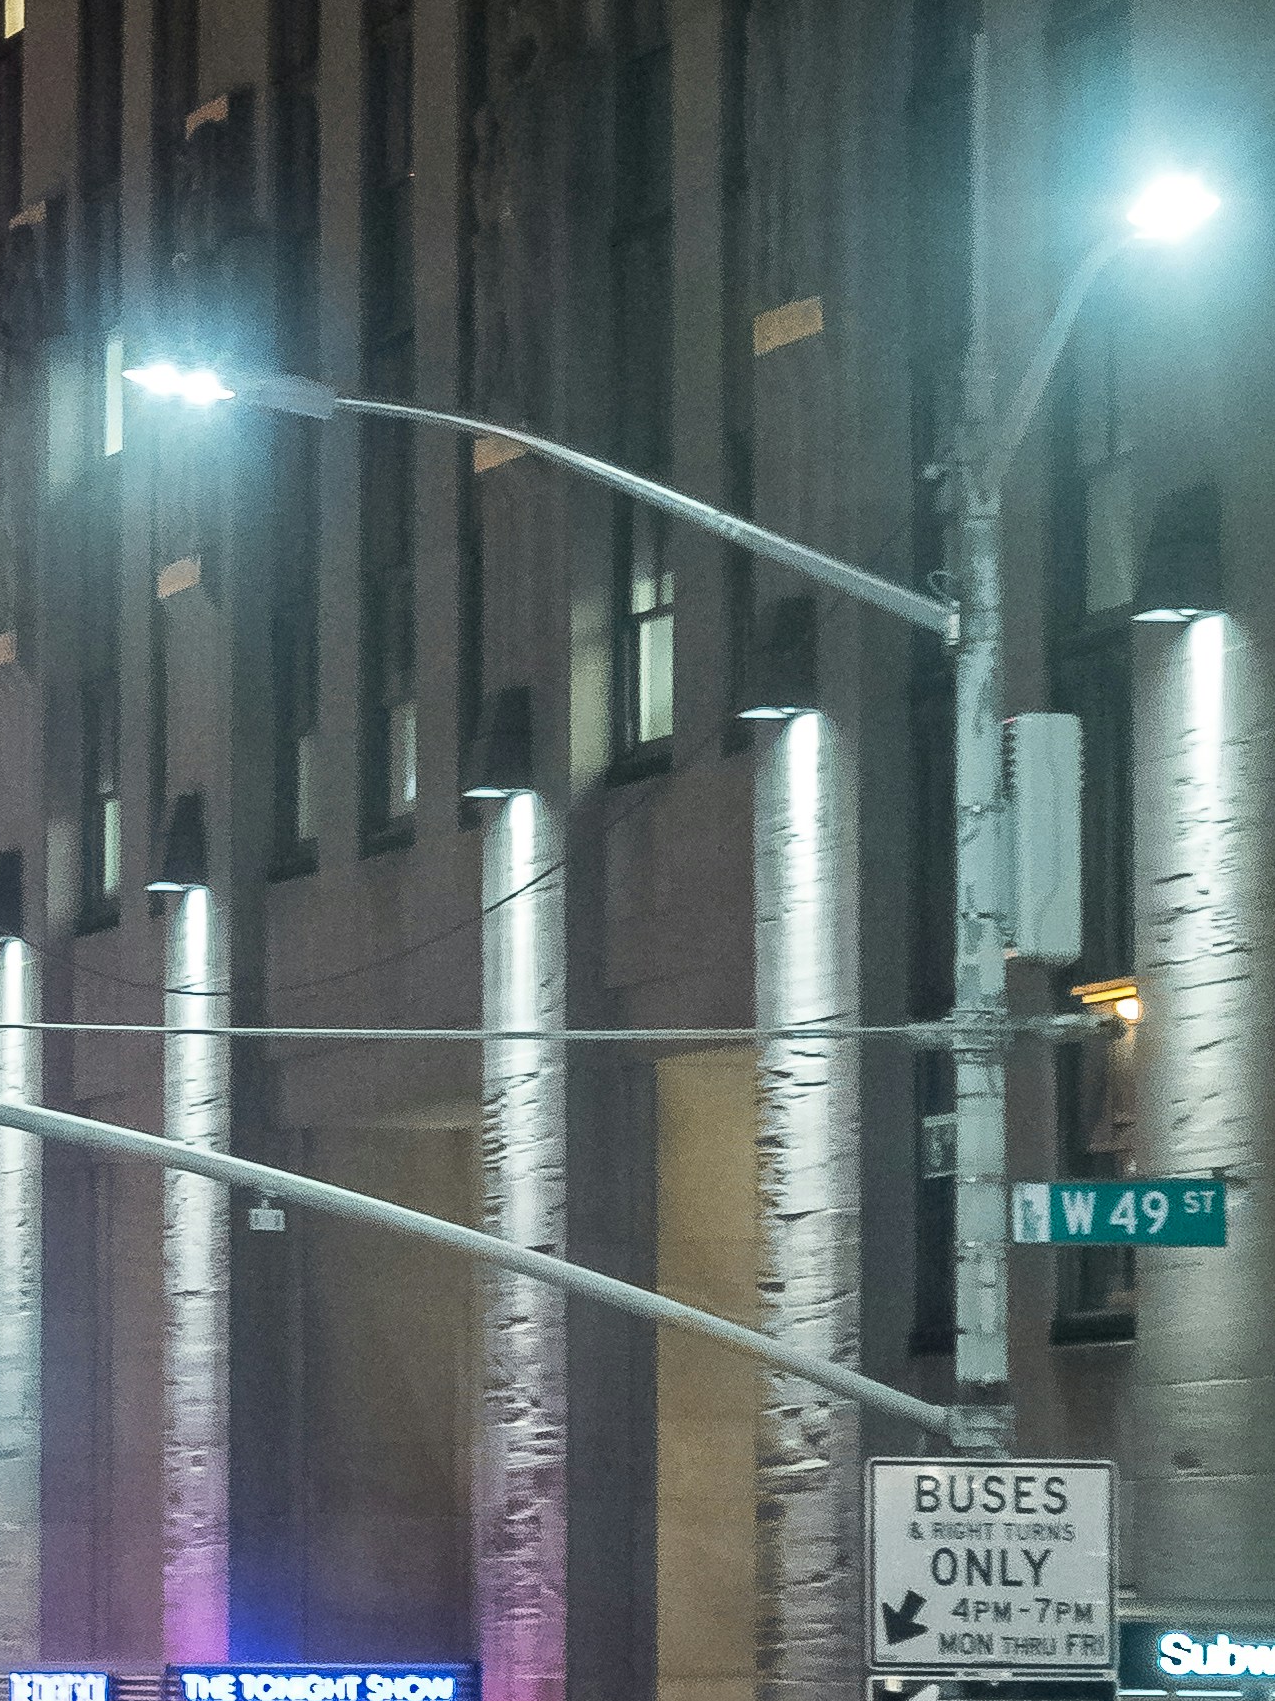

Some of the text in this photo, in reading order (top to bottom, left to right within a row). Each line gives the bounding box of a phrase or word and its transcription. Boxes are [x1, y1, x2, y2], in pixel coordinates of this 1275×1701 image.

[1061, 1190, 1216, 1235] W 49 ST
[914, 1474, 1069, 1515] BUSES
[907, 1521, 1076, 1542] & RIGHT TURNS
[930, 1547, 1054, 1587] ONLY
[938, 1631, 1105, 1655] MON THRU FRI
[181, 1673, 237, 1701] THE
